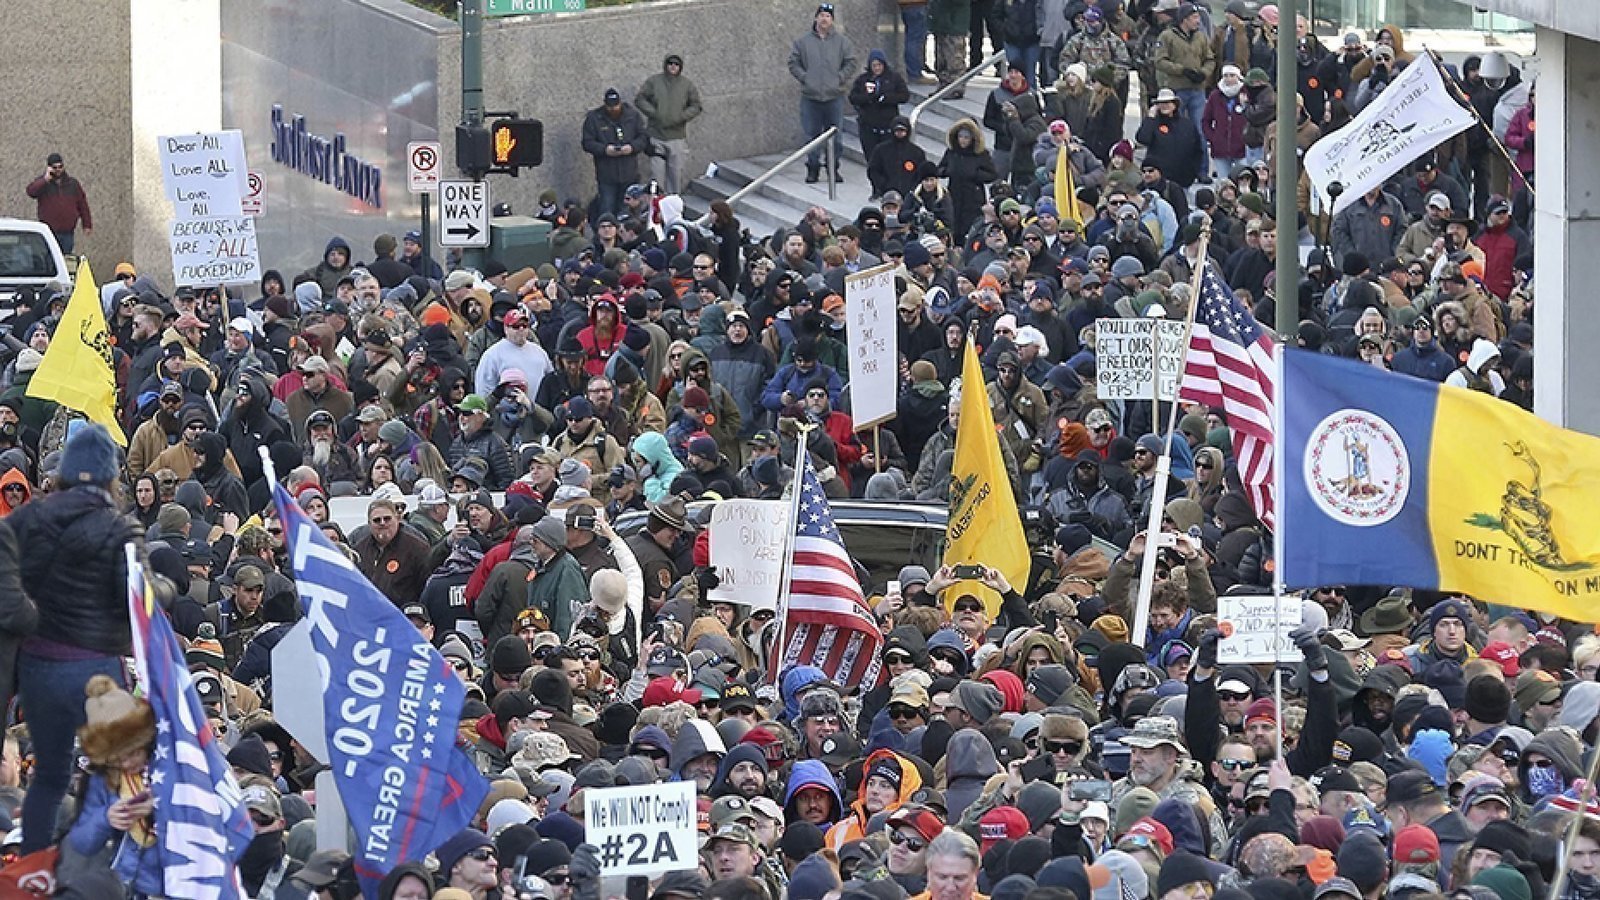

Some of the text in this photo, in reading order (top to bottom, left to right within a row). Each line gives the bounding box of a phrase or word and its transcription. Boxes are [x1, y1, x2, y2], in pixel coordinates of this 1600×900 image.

[511, 0, 553, 11] Main
[168, 138, 197, 153] Dear
[172, 163, 202, 176] Love
[445, 186, 483, 201] ONE
[192, 203, 209, 216] All
[445, 204, 483, 219] WAY
[234, 219, 254, 233] WE
[174, 238, 249, 258] ARE ALL
[1098, 337, 1153, 355] GET OUR
[1098, 355, 1153, 370] FREEDOM
[1455, 540, 1501, 561] DONT
[1554, 580, 1579, 597] ON
[591, 792, 690, 830] We Will NOT Comply
[601, 832, 679, 868] #2A
